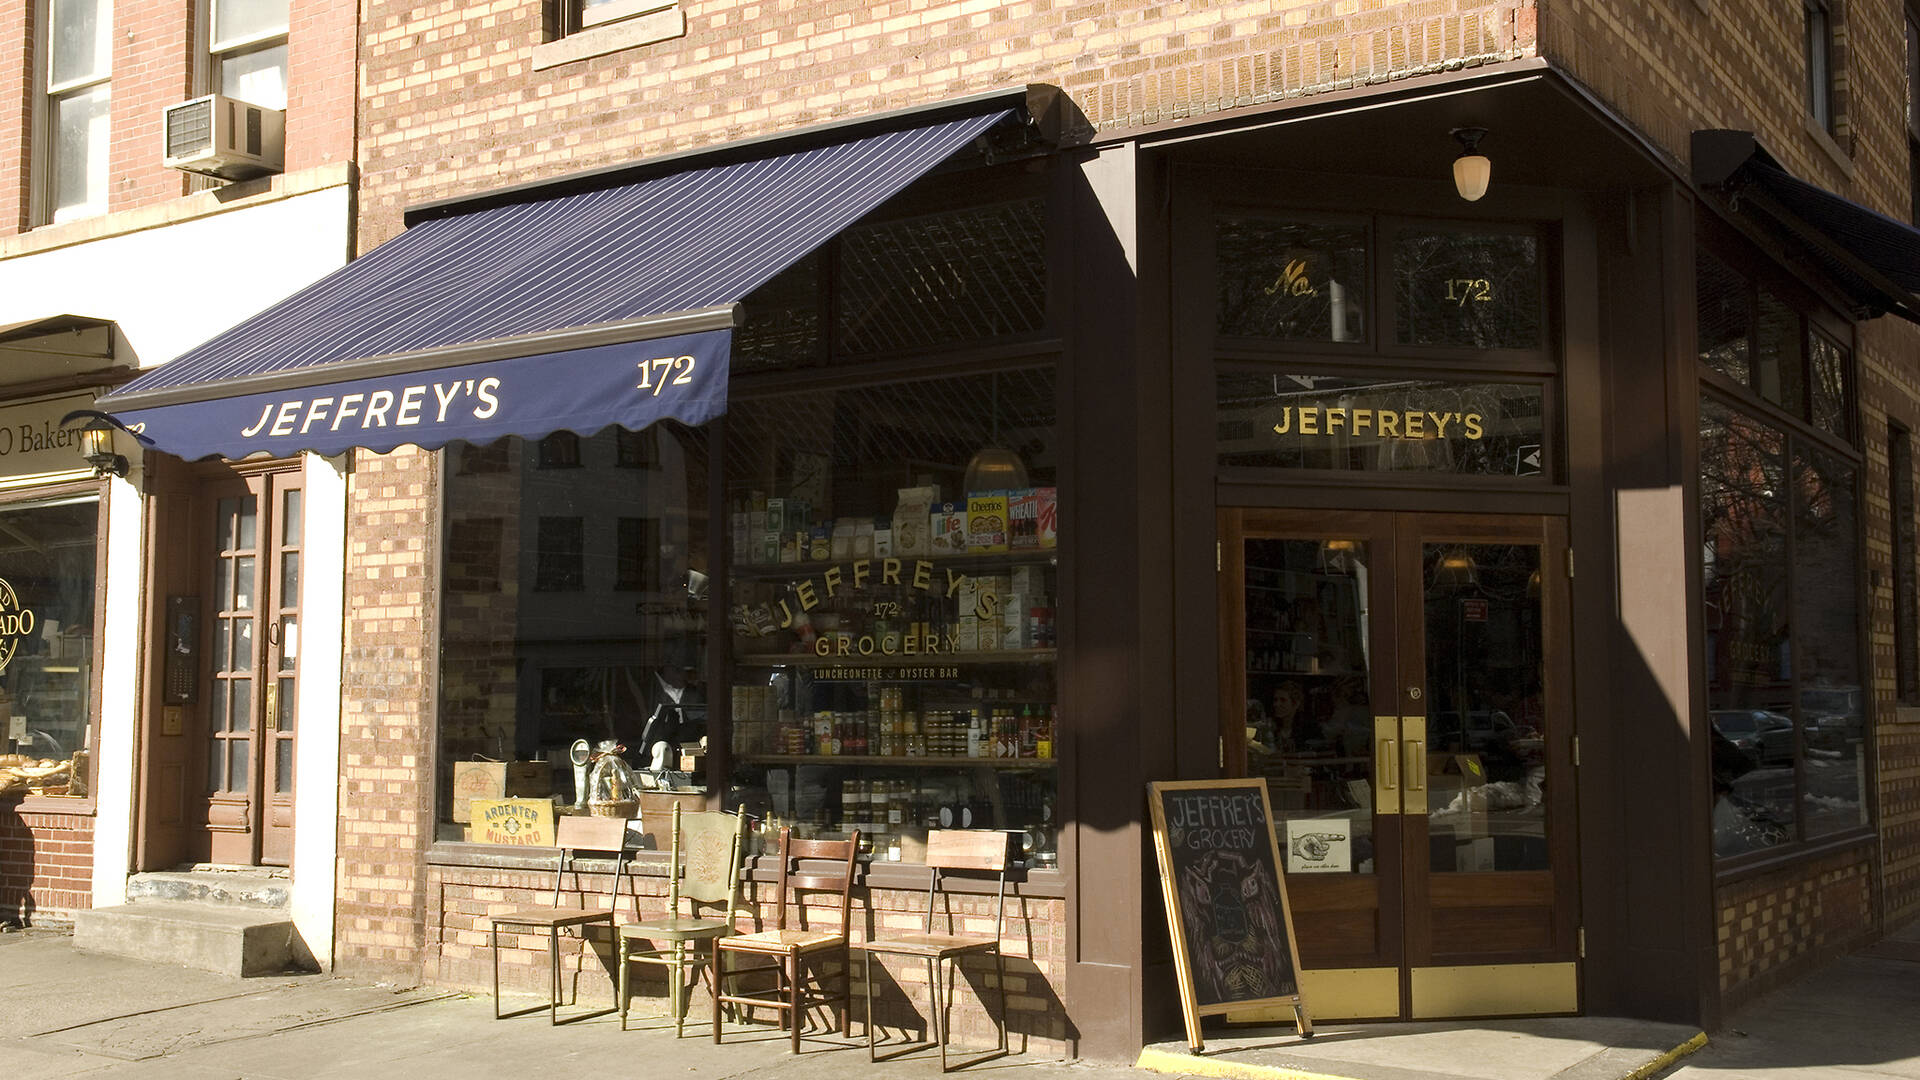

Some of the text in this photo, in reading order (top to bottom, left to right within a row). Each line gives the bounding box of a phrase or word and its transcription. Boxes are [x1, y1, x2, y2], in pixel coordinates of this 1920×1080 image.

[1444, 278, 1492, 307] 172
[241, 355, 696, 438] JEFFREY'S 172
[1273, 406, 1484, 440] JEFFREY'S
[779, 558, 999, 629] JEFFREY'S
[873, 601, 899, 618] 172
[815, 635, 962, 656] GROCERY
[814, 668, 883, 680] LUNCHEONETTE
[900, 668, 935, 680] OYSTER
[939, 667, 959, 679] BAR
[485, 804, 539, 822] ARDENTER
[486, 829, 541, 847] MUSTARD
[1187, 827, 1256, 850] GROCERY
